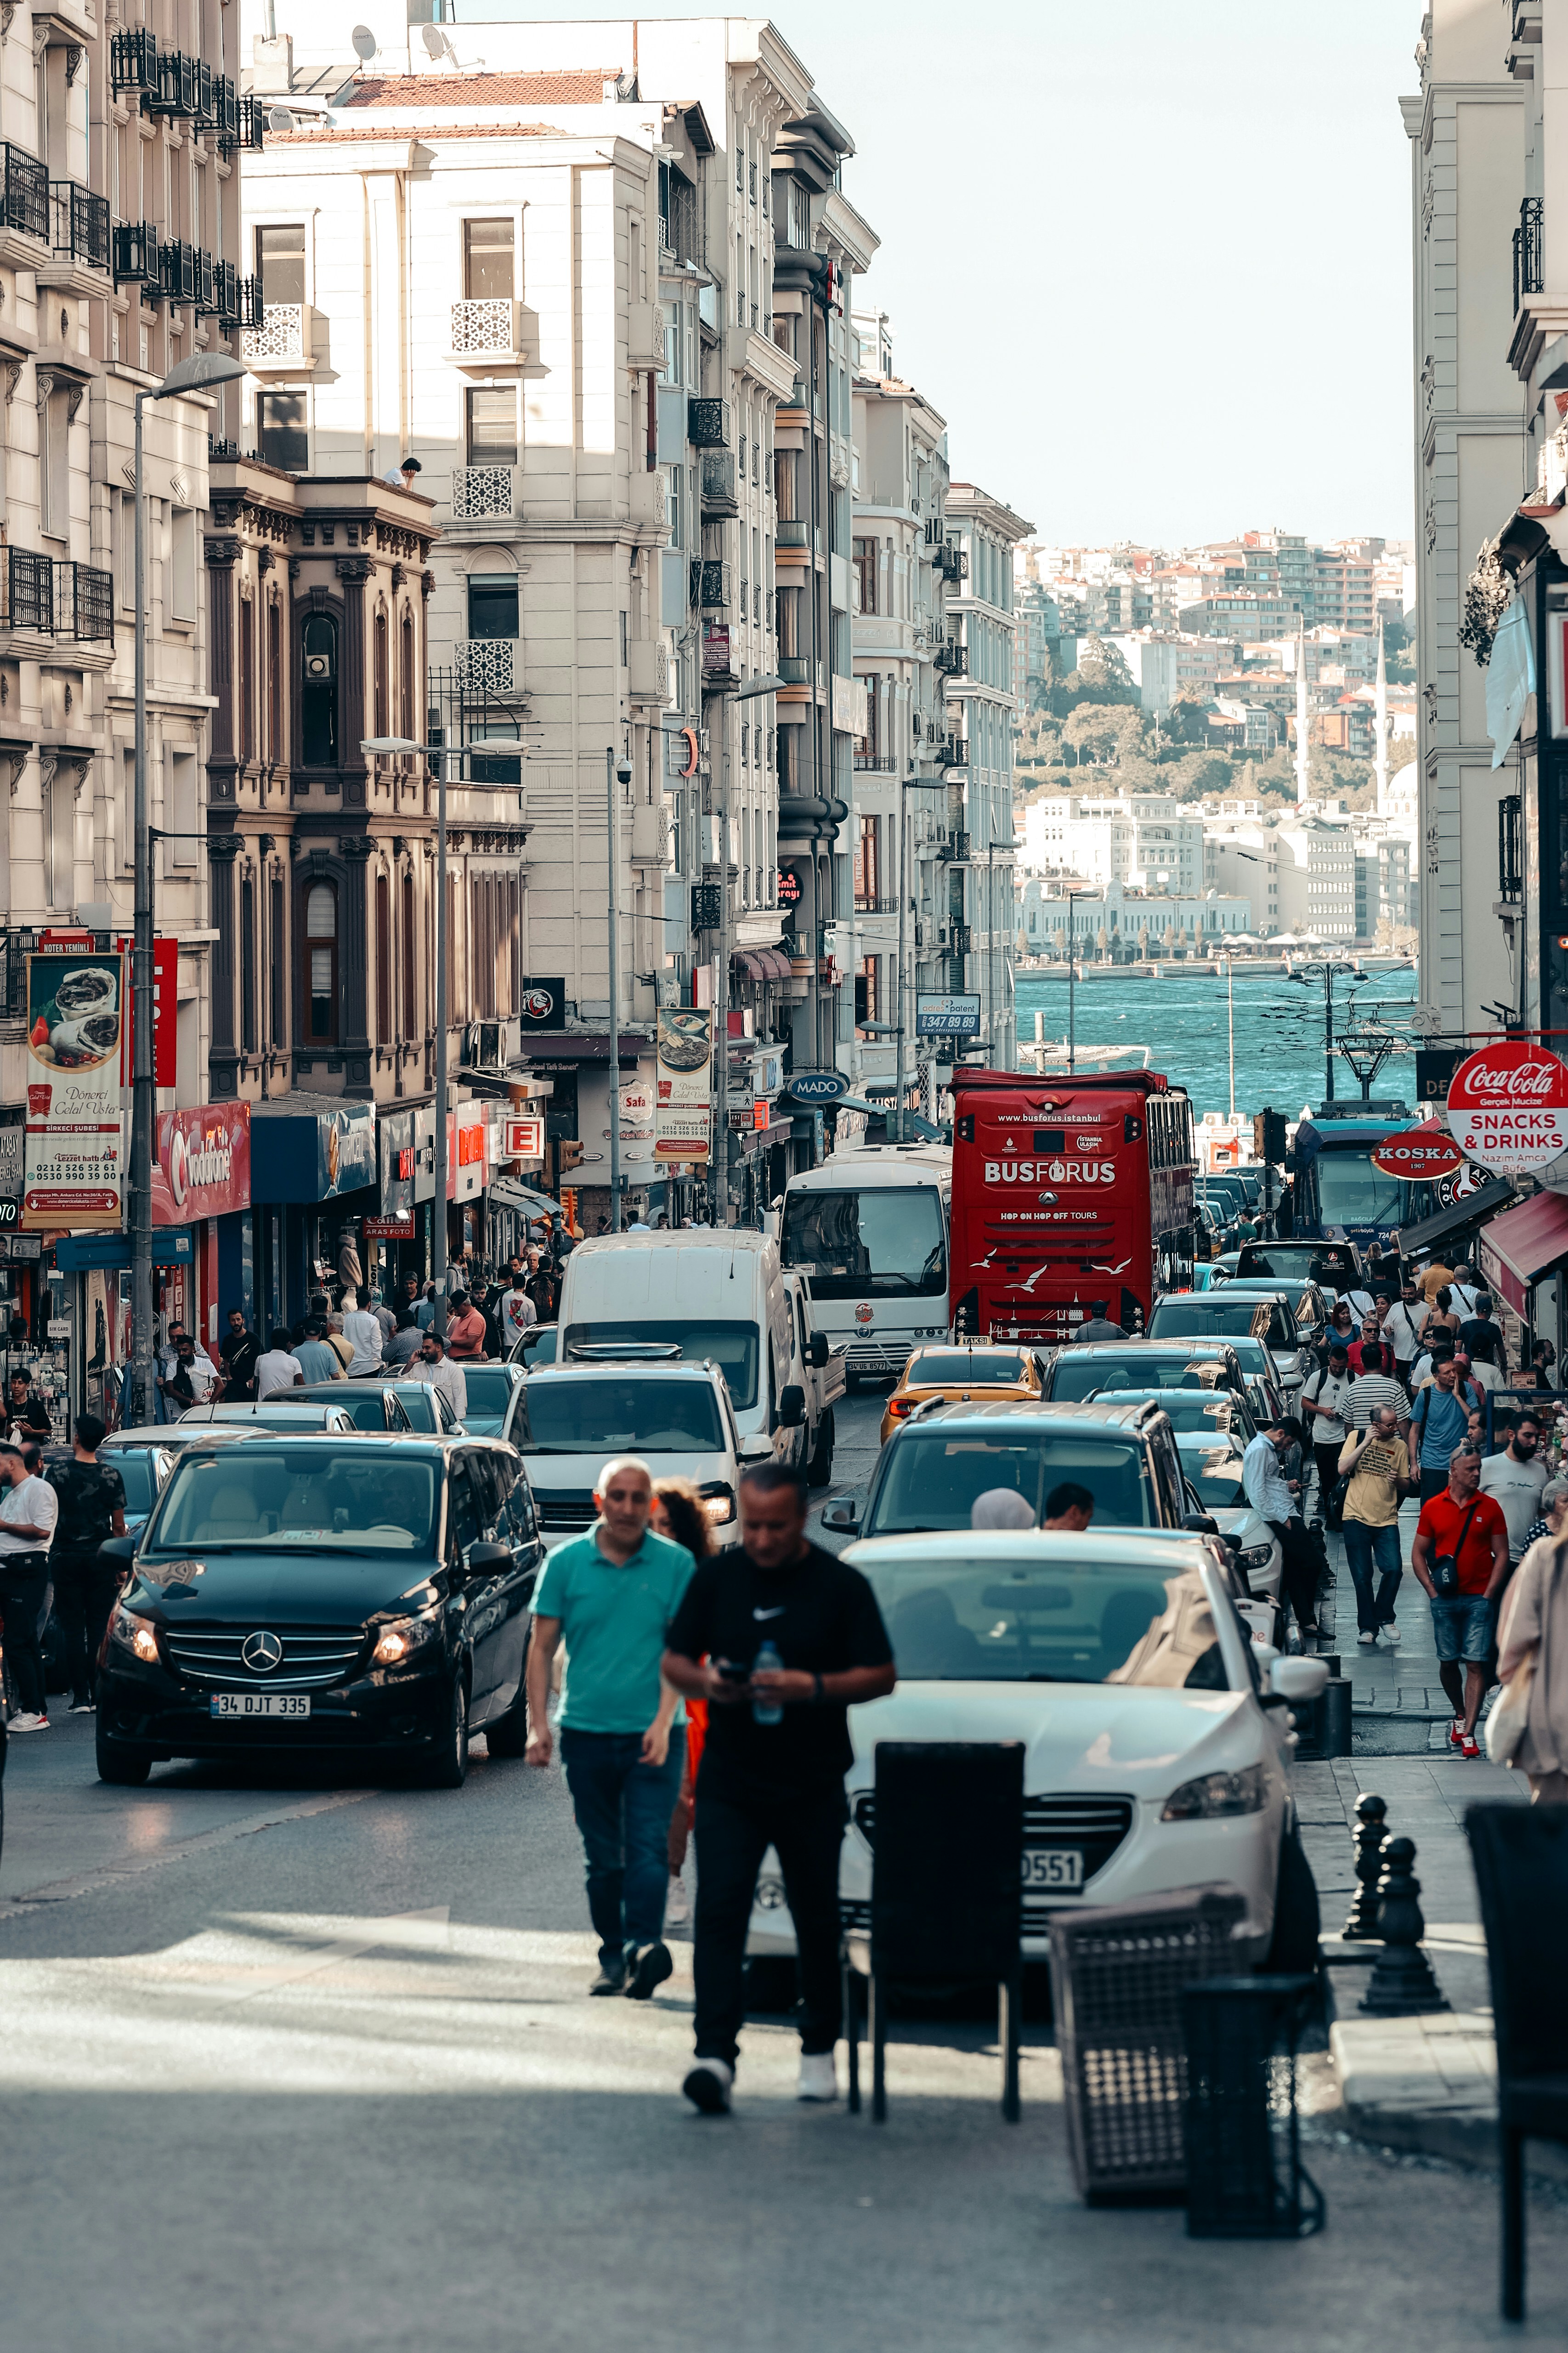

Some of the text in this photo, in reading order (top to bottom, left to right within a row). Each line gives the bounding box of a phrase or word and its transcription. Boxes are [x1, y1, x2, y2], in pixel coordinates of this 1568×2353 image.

[778, 890, 800, 900] rayı
[44, 941, 90, 953] NOTER YEMİNLİ
[950, 1005, 975, 1013] patent
[927, 1016, 947, 1028] 347
[948, 1016, 961, 1028] 89
[962, 1016, 976, 1028] 89
[1464, 1062, 1559, 1095] Coca-Cola
[679, 1082, 703, 1090] Dönerci
[797, 1081, 838, 1093] MADO
[66, 1087, 108, 1100] Dönerci
[626, 1096, 645, 1107] Safa
[1480, 1098, 1510, 1107] Gerçek
[55, 1101, 115, 1115] Celal Usta
[998, 1113, 1101, 1122] www.busforus.istanbul
[1471, 1114, 1556, 1129] SNACKS
[74, 1124, 99, 1133] ŞUBESİ
[513, 1126, 533, 1151] E
[1464, 1134, 1563, 1149] & DRINKS
[1378, 1148, 1458, 1159] KOSKA
[186, 1139, 230, 1187] vodafone
[1502, 1164, 1526, 1173] Büfe
[985, 1162, 1115, 1183] BUSFORUS
[0, 1204, 16, 1221] TO
[221, 1696, 306, 1713] 34 DJT 335
